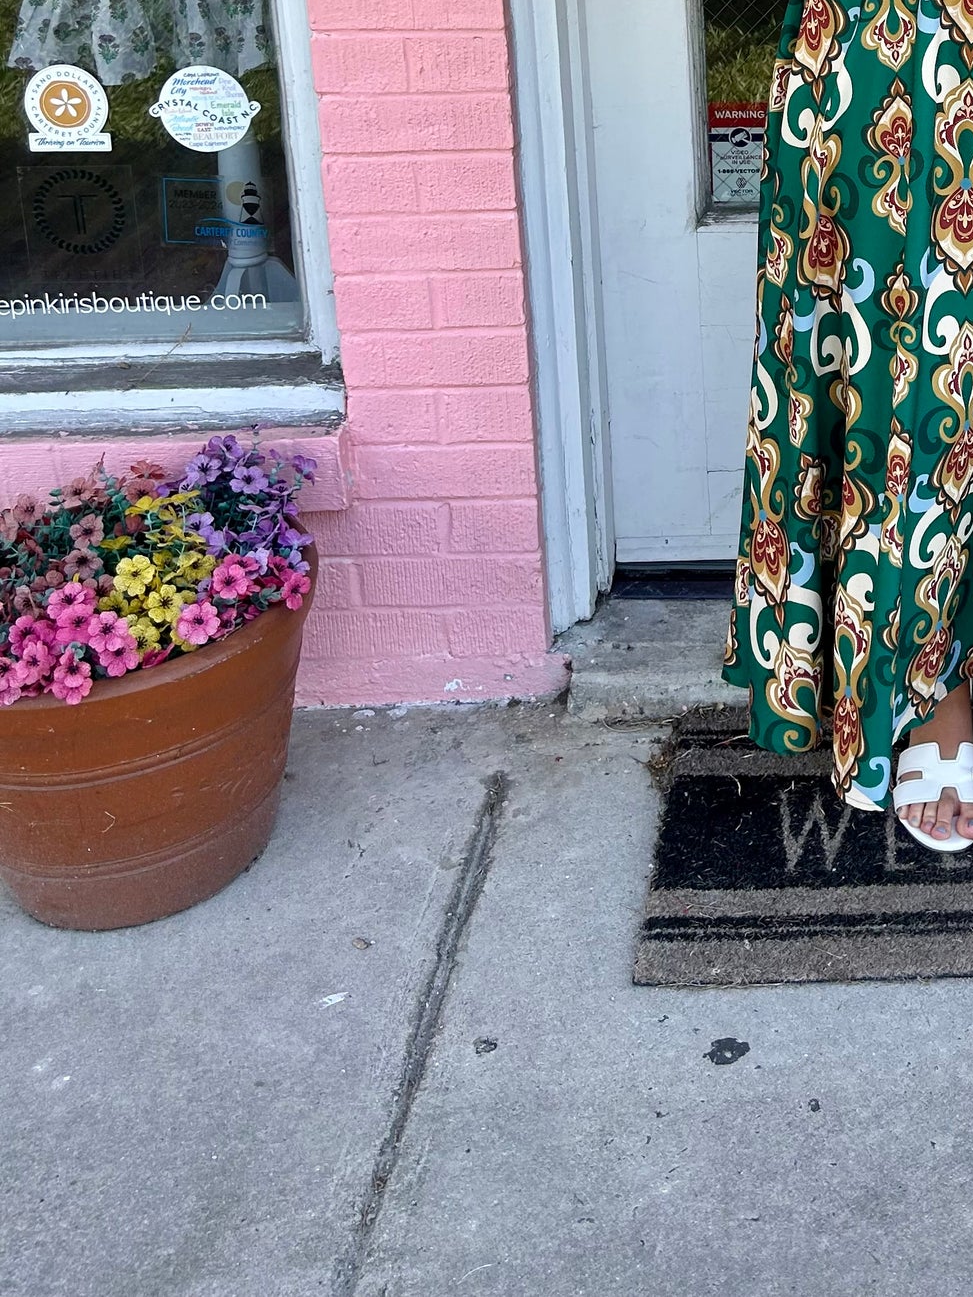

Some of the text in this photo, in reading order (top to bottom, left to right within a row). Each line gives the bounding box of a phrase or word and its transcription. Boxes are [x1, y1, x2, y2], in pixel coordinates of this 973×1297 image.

[32, 71, 98, 95] SAND DOLLARS
[172, 77, 217, 86] Morehead
[170, 86, 187, 96] City
[210, 101, 242, 109] Emerald
[152, 99, 199, 115] CRYSTAL
[202, 109, 238, 124] COAST
[714, 110, 766, 119] WARNING
[32, 106, 102, 137] CARTERET COUNTY
[193, 132, 239, 141] BEAUFORT
[35, 137, 64, 148] Thriving
[76, 137, 105, 146] Tourism
[174, 189, 217, 199] MEMBER
[195, 226, 269, 238] CARTERET COUNTY
[0, 291, 267, 319] epinkirisboutique.com
